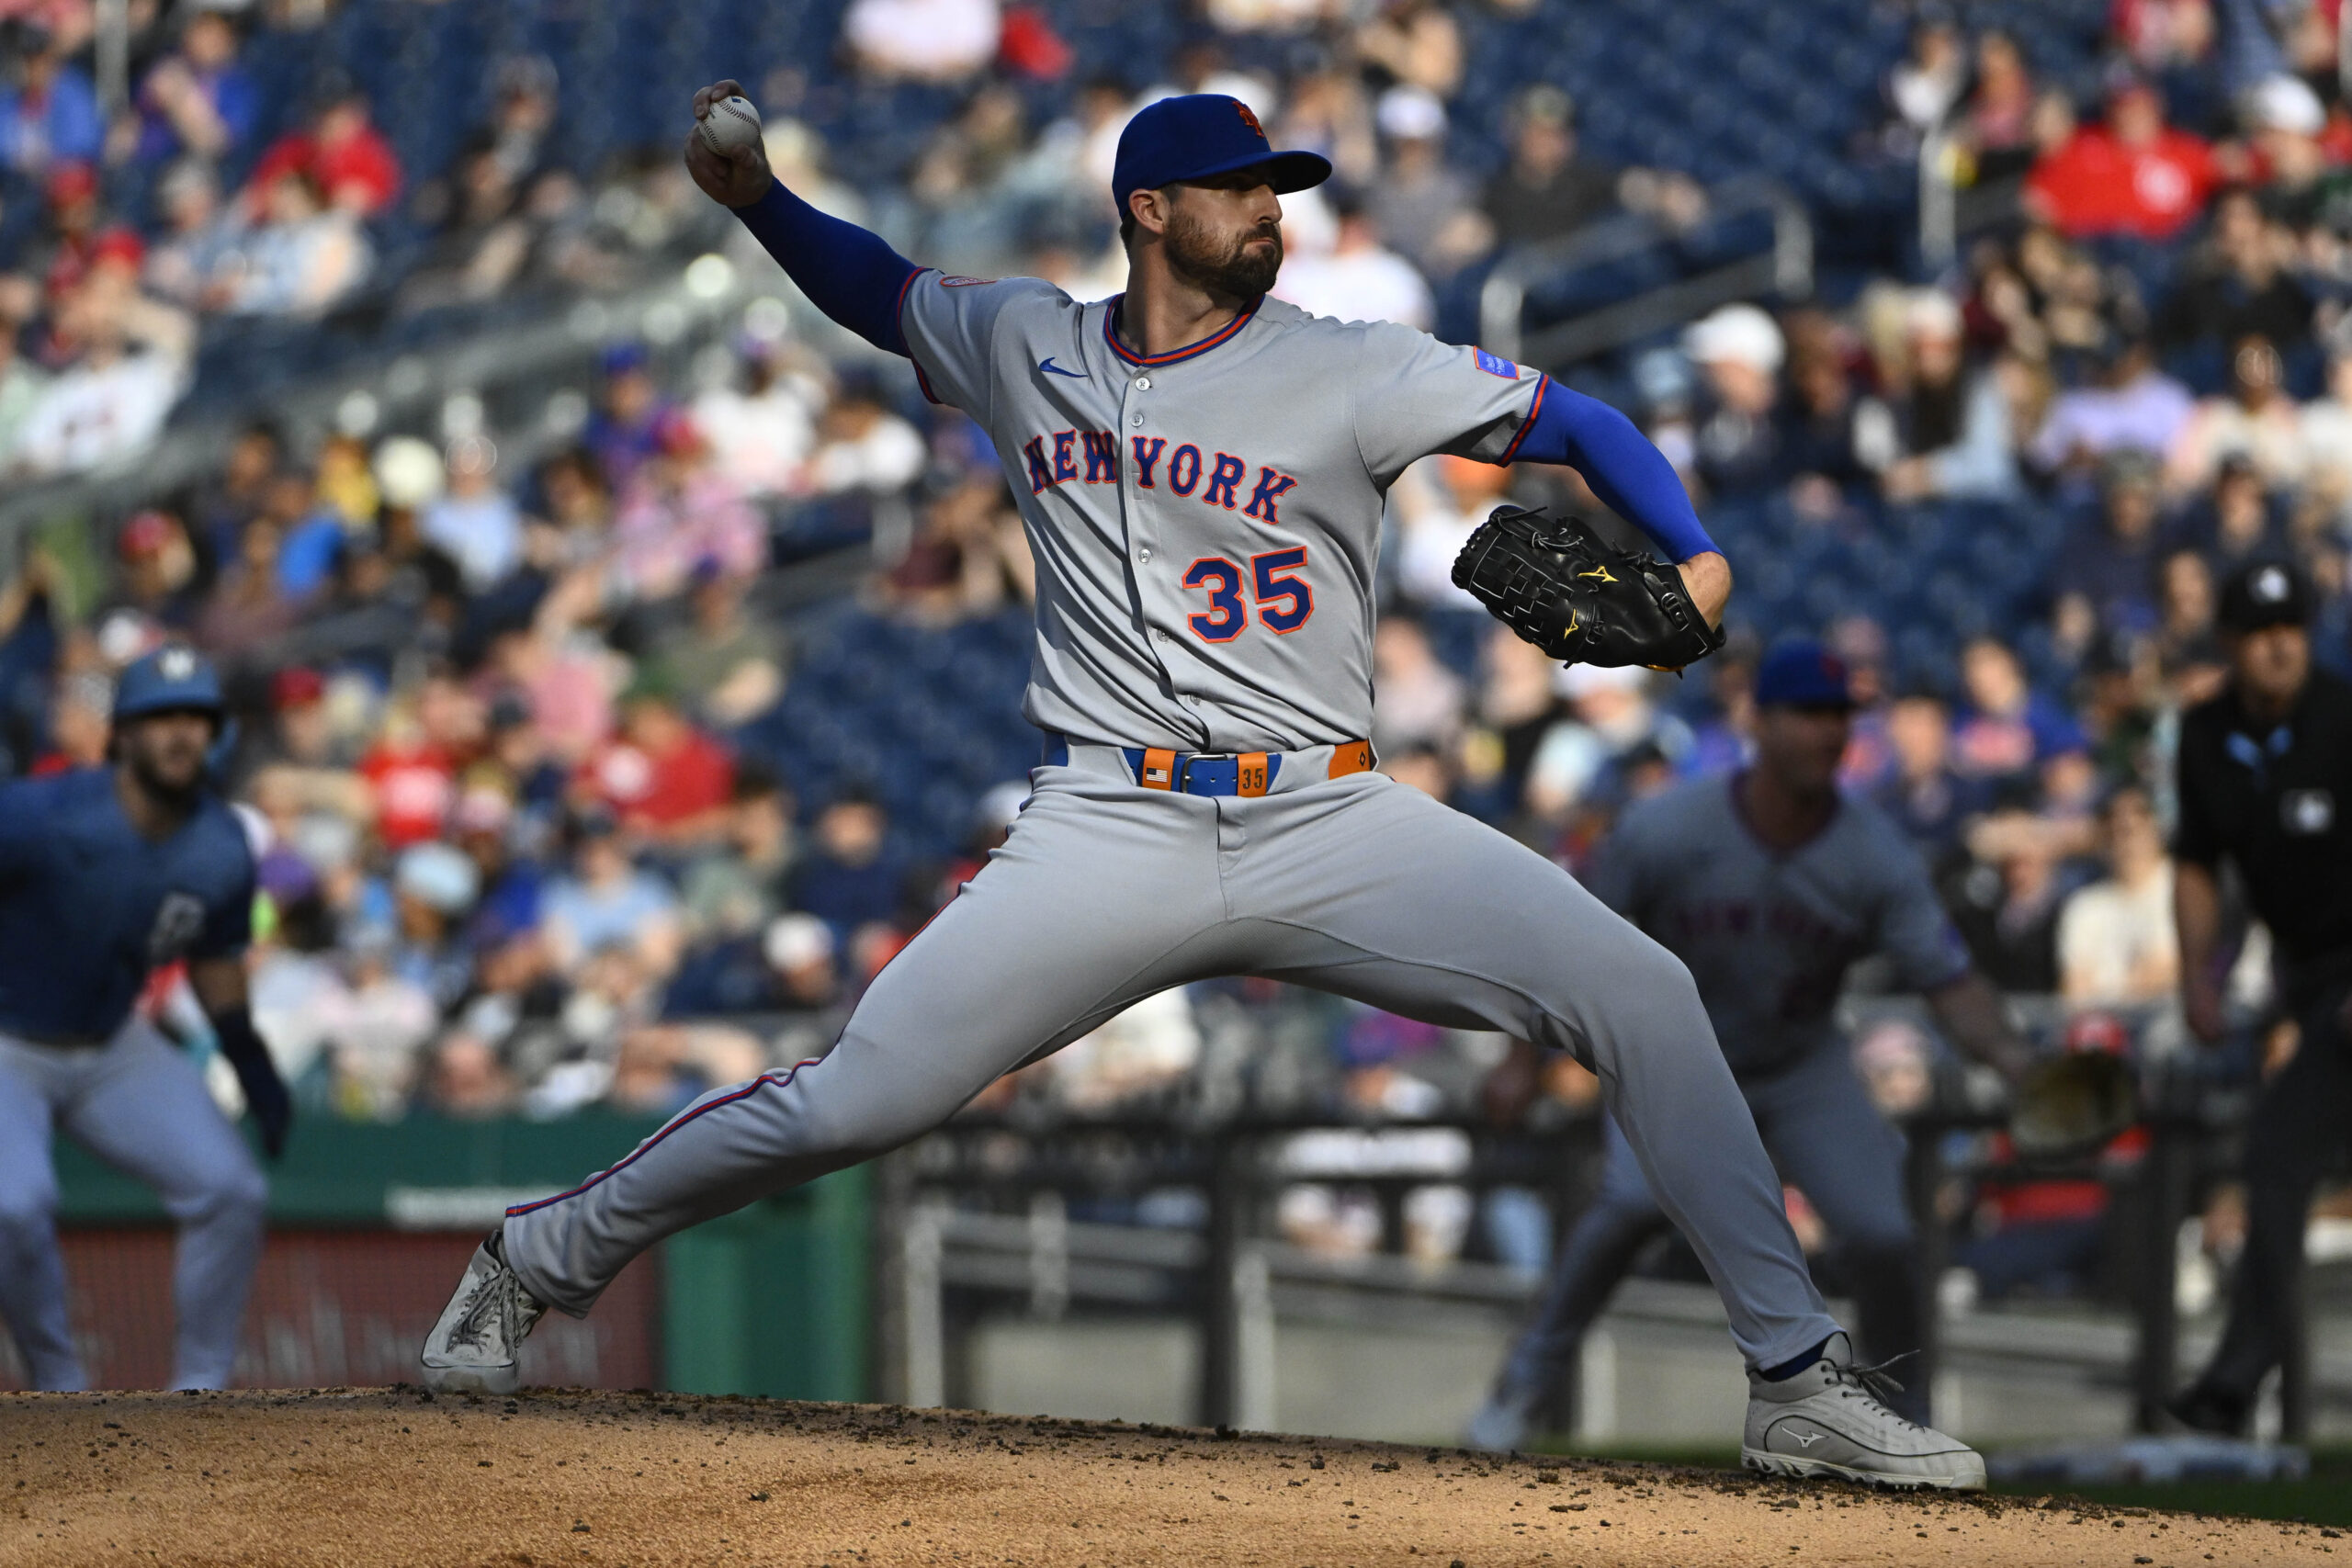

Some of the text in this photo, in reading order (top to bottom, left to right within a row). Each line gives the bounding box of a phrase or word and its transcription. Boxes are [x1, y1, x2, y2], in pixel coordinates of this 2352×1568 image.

[1023, 428, 1297, 525] NEW YORK
[1182, 546, 1314, 643] 35
[1242, 768, 1263, 789] 35
